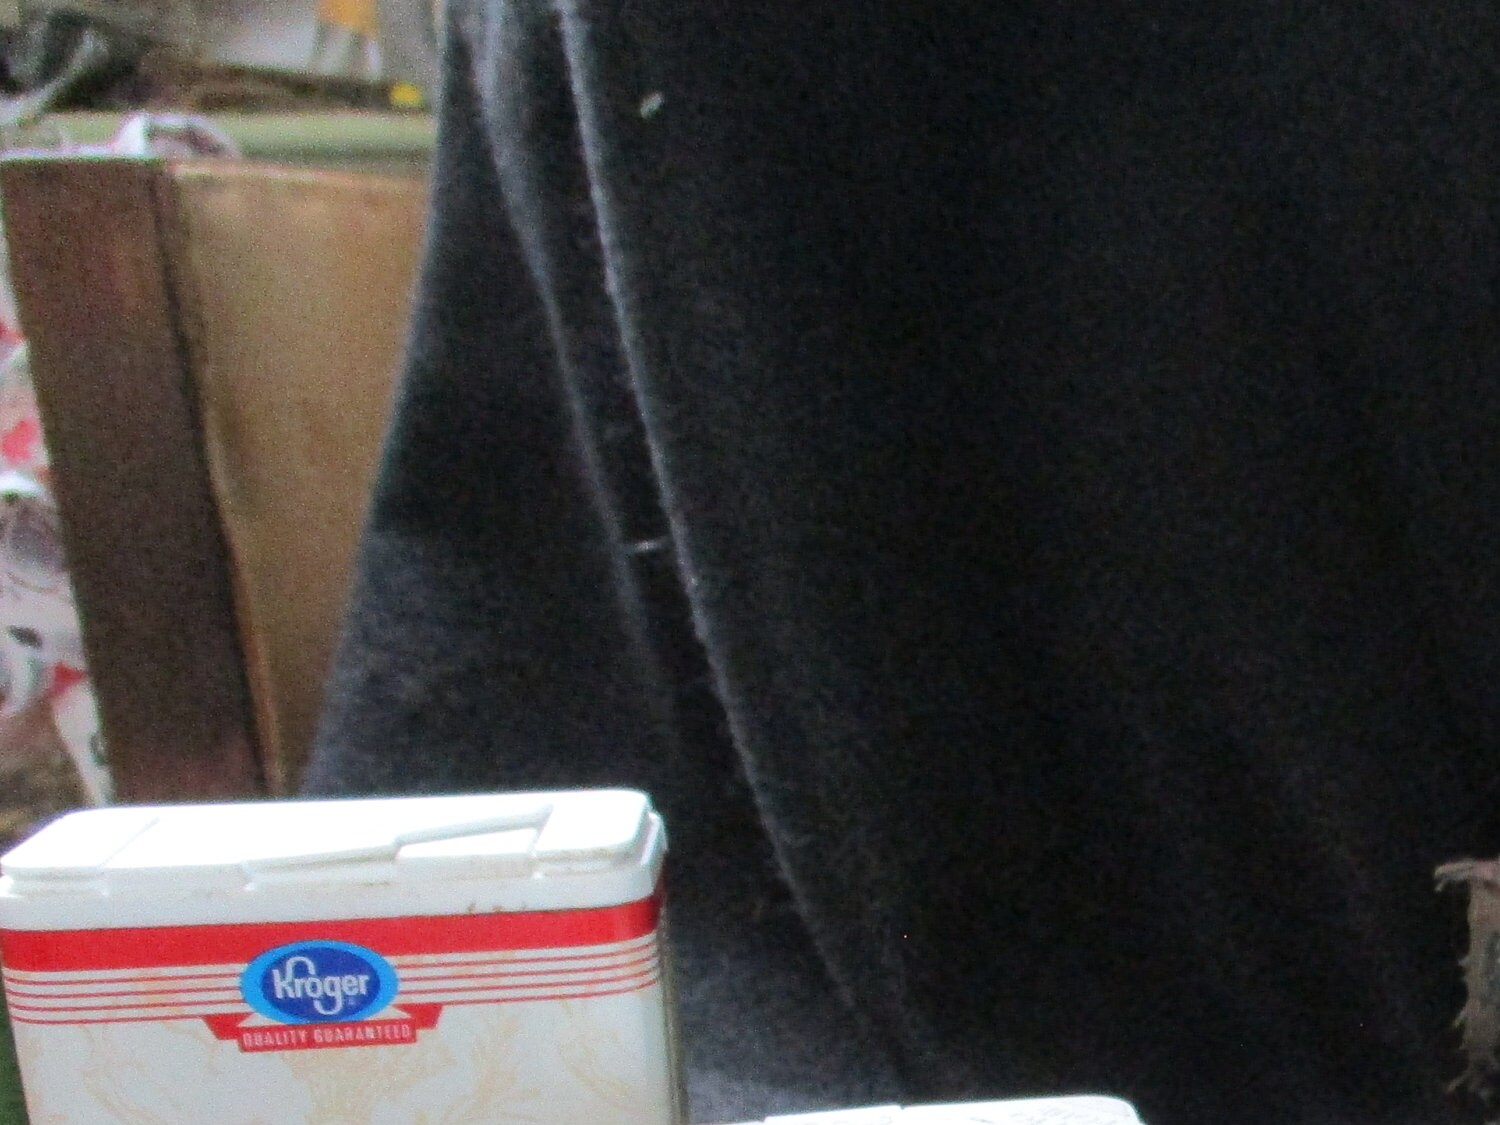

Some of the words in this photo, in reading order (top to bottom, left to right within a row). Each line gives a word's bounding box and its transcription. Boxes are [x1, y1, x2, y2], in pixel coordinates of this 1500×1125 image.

[272, 956, 369, 1015] Kroger
[243, 1029, 308, 1048] QUALITY
[313, 1023, 412, 1044] GUARANTEED
